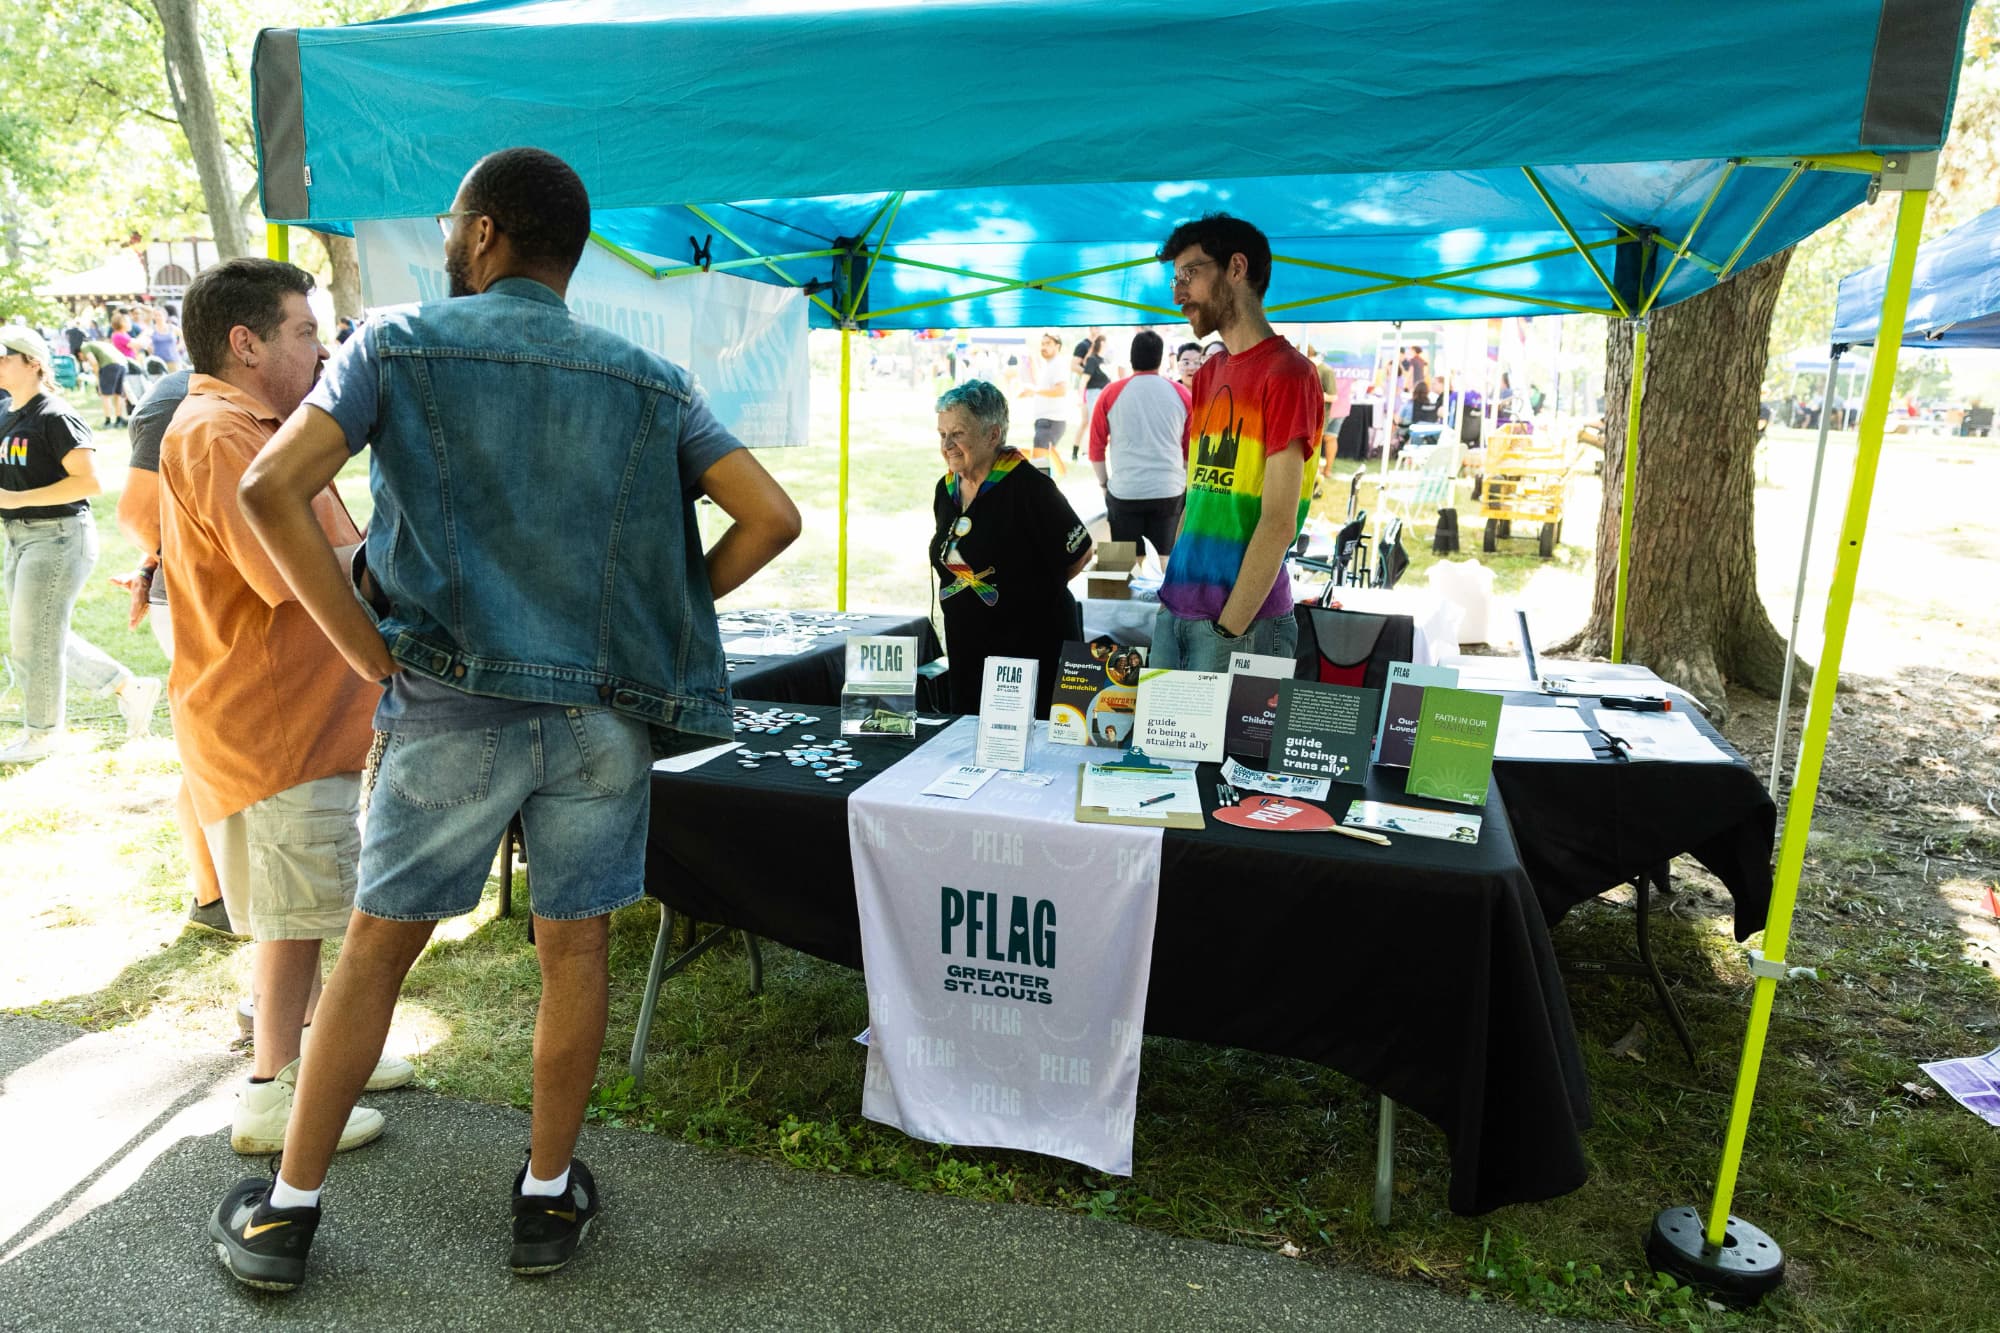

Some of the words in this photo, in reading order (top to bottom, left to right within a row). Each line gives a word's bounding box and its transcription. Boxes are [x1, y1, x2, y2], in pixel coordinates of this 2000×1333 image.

[860, 644, 903, 672] PFLAG
[1234, 658, 1251, 670] PFLAG
[1063, 668, 1079, 676] Your
[1064, 661, 1102, 671] Supporting
[1392, 666, 1411, 679] PFLAG
[996, 665, 1023, 684] PFLAG
[1060, 683, 1098, 692] Grandchild
[1241, 715, 1275, 726] Childre
[1263, 710, 1276, 719] Ou
[1398, 717, 1415, 726] Our
[1434, 713, 1457, 724] FAITH
[1459, 716, 1468, 725] IN
[1469, 719, 1488, 728] OUR
[1147, 718, 1177, 727] guide
[1389, 724, 1417, 734] Loved
[1434, 720, 1484, 736] FAMILIES
[1159, 728, 1188, 739] being
[1145, 737, 1187, 748] straight
[1188, 739, 1209, 751] ally
[1285, 736, 1323, 749] guide
[1284, 747, 1299, 757] to
[1300, 748, 1338, 764] being
[1339, 755, 1349, 764] a
[959, 766, 985, 774] PFLAG
[1282, 758, 1319, 772] trans
[1320, 762, 1345, 777] ally
[972, 828, 1025, 867] PFLAG
[941, 886, 1057, 969] PFLAG
[947, 964, 1049, 991] GREATER
[944, 979, 977, 995] ST.
[981, 983, 1053, 1005] LOUIS
[971, 1002, 1023, 1037] PFLAG
[906, 1036, 957, 1070] PFLAG
[1039, 1052, 1090, 1086] PFLAG
[970, 1082, 1021, 1117] PFLAG
